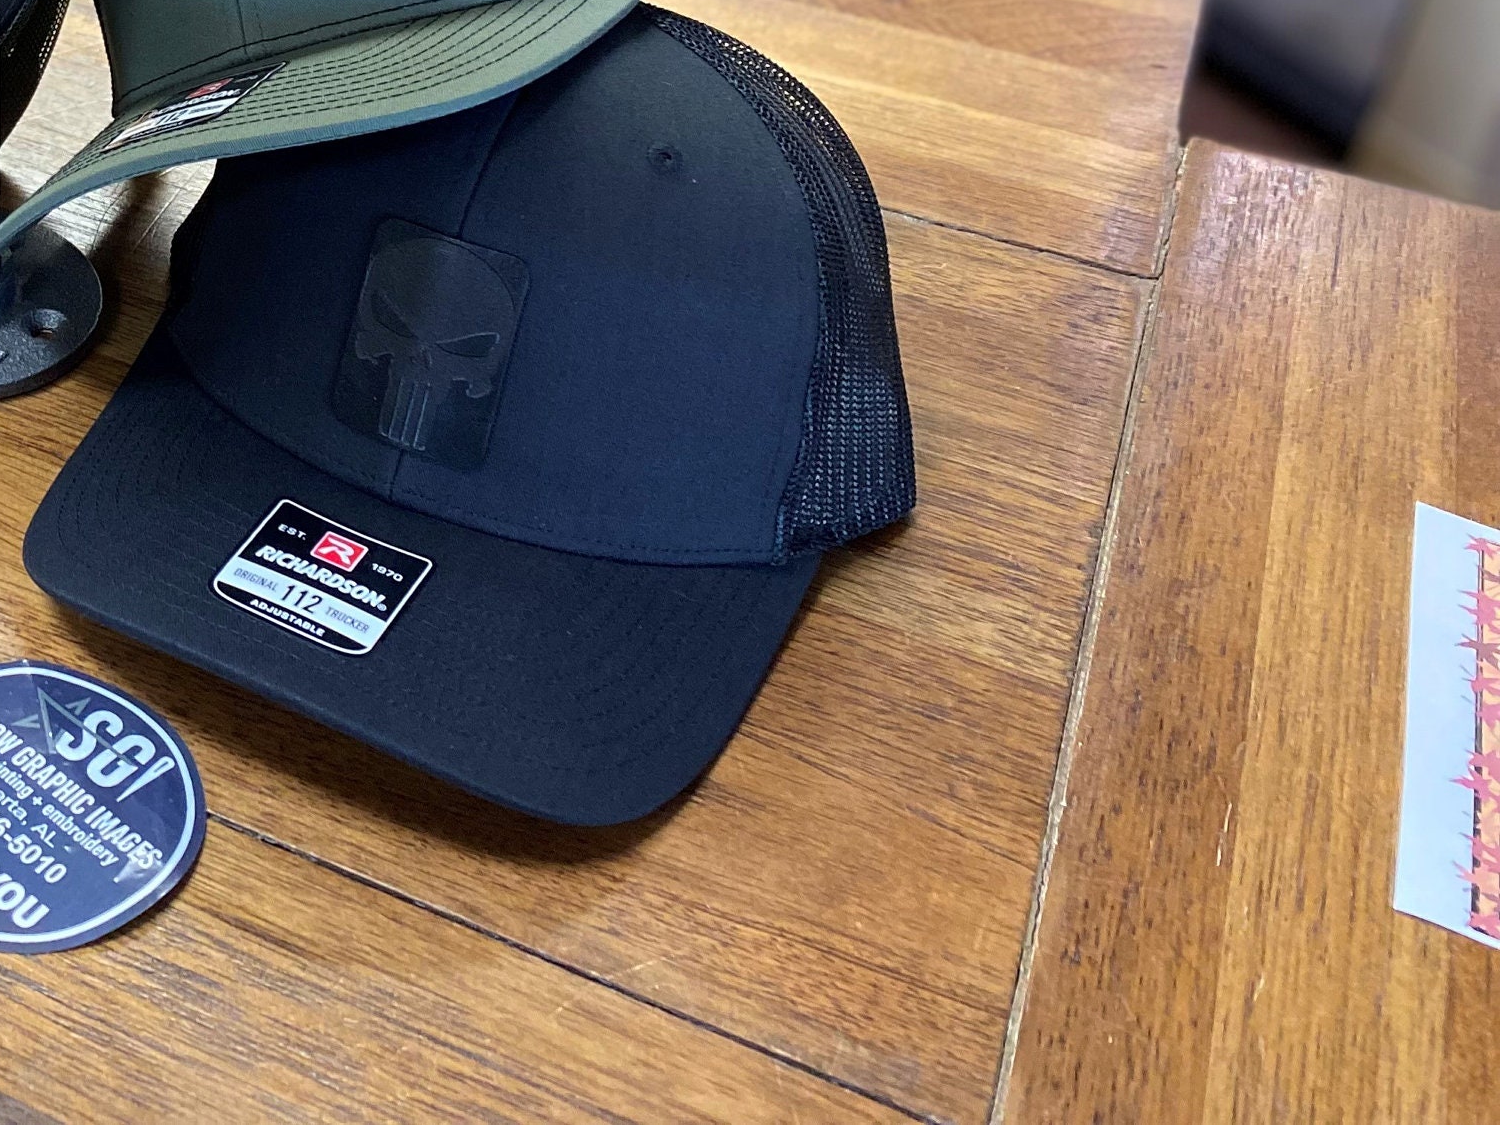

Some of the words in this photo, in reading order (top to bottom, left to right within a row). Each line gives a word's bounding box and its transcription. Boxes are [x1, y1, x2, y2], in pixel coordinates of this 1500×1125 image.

[277, 523, 306, 541] EST.
[371, 562, 404, 583] 1970
[233, 567, 280, 593] ORIGINAL
[280, 583, 324, 615] 112
[325, 606, 371, 634] TRUCKER
[250, 598, 326, 637] ADJUSTABLE
[11, 744, 95, 815] GRAPHIC
[84, 805, 163, 871] IMAGES
[31, 821, 56, 849] AL
[41, 803, 119, 868] embroidery
